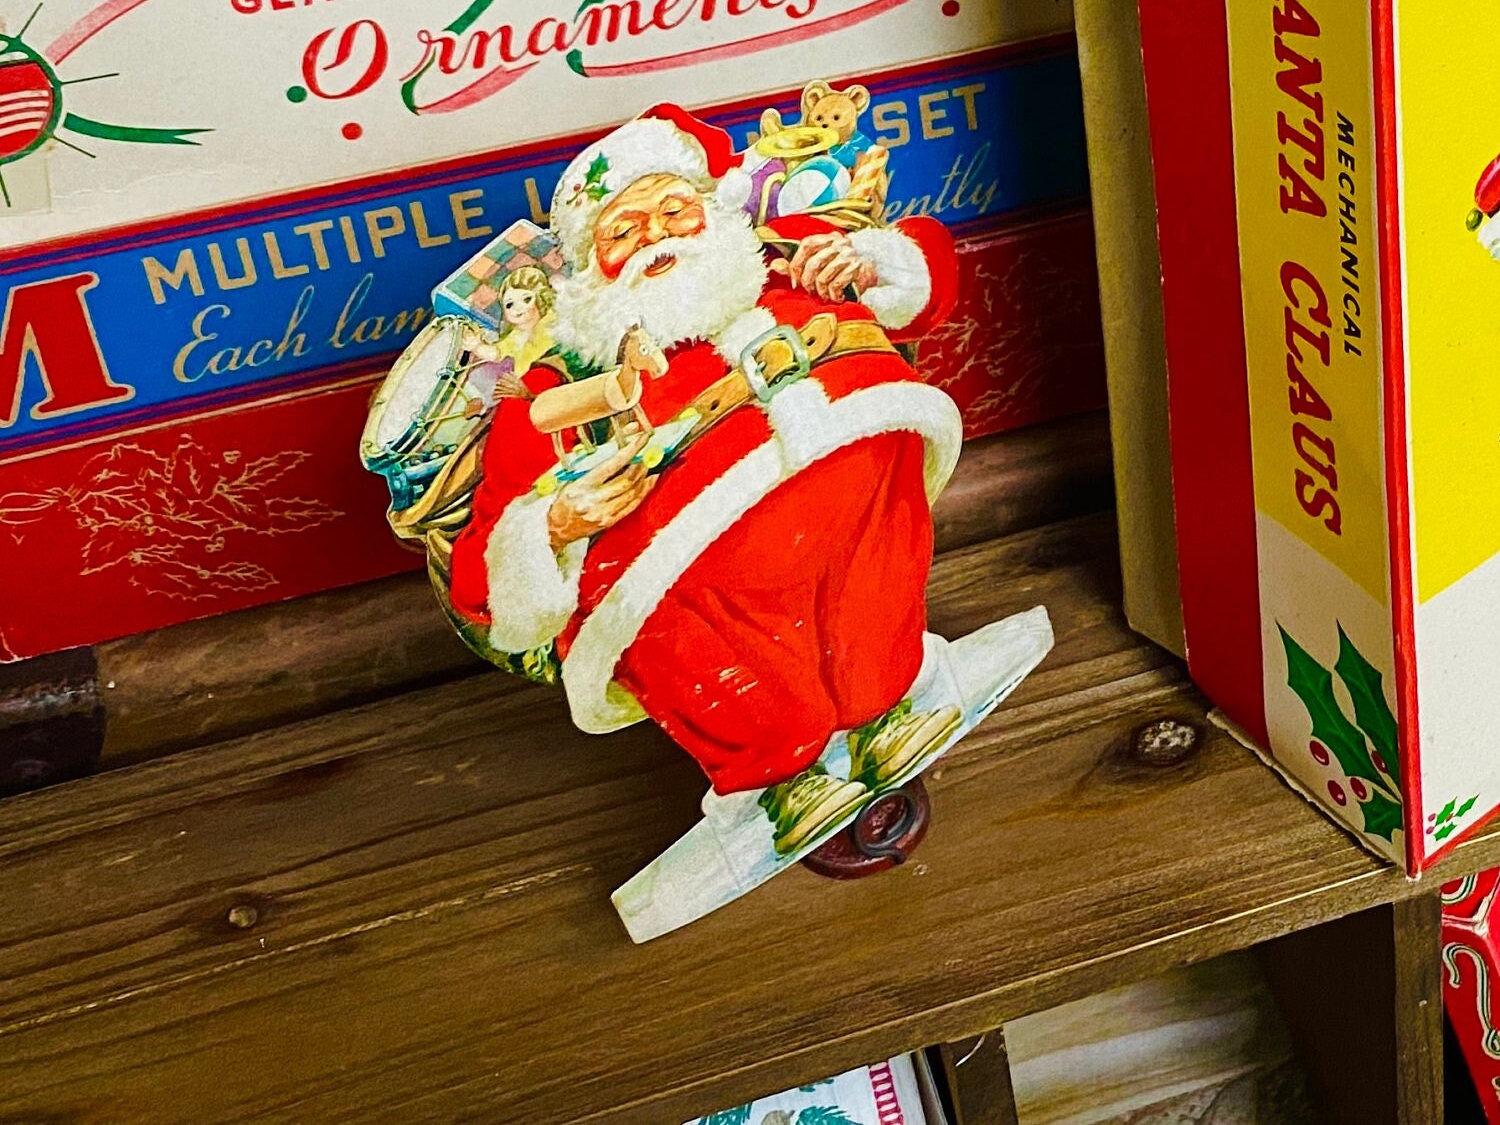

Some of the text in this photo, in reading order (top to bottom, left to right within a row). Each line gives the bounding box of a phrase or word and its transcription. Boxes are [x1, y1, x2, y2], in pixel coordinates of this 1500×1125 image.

[142, 188, 492, 305] MULTIPLE
[871, 83, 986, 151] SET
[1335, 110, 1364, 358] MECHANICAL
[172, 285, 315, 384] Each
[1280, 261, 1342, 538] CLAUS
